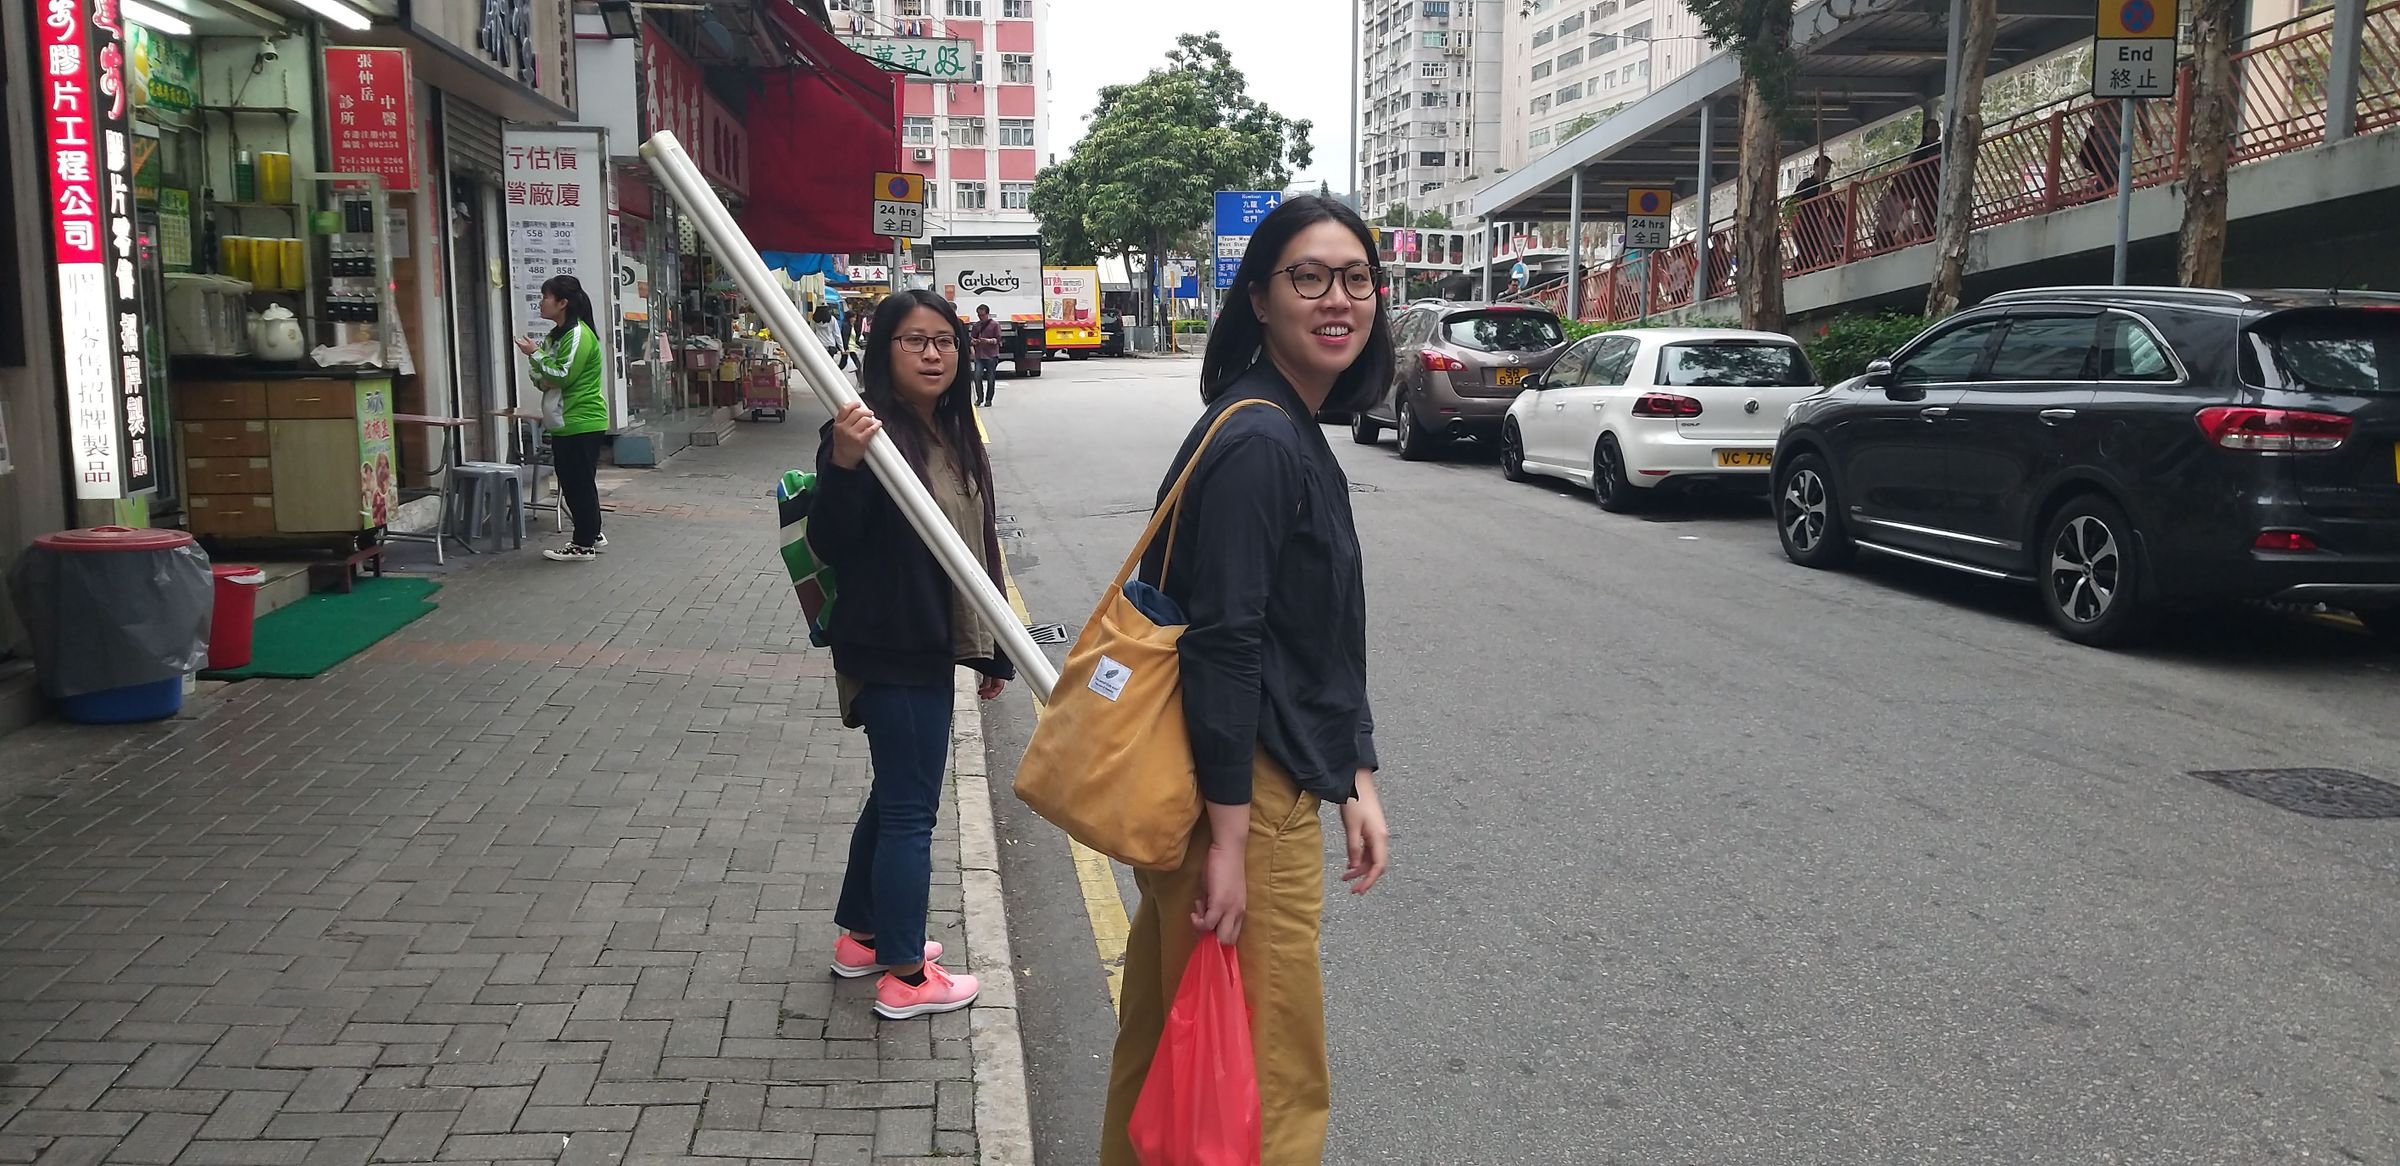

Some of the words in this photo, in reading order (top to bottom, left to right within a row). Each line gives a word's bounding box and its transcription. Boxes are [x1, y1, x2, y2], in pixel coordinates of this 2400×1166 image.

[2119, 46, 2153, 61] End
[2109, 68, 2158, 89] 終止
[339, 95, 355, 126] 診所
[880, 205, 895, 215] 24
[899, 206, 917, 216] hrs
[883, 218, 912, 232] 全日
[1631, 219, 1646, 228] 24
[1648, 220, 1665, 229] hrs
[1634, 232, 1660, 244] 全日
[851, 267, 884, 279] 五金
[958, 269, 1020, 294] Carlsberg
[1505, 368, 1520, 377] SR
[1499, 376, 1521, 385] 632
[1722, 453, 1740, 465] VC
[1746, 452, 1773, 465] 779
